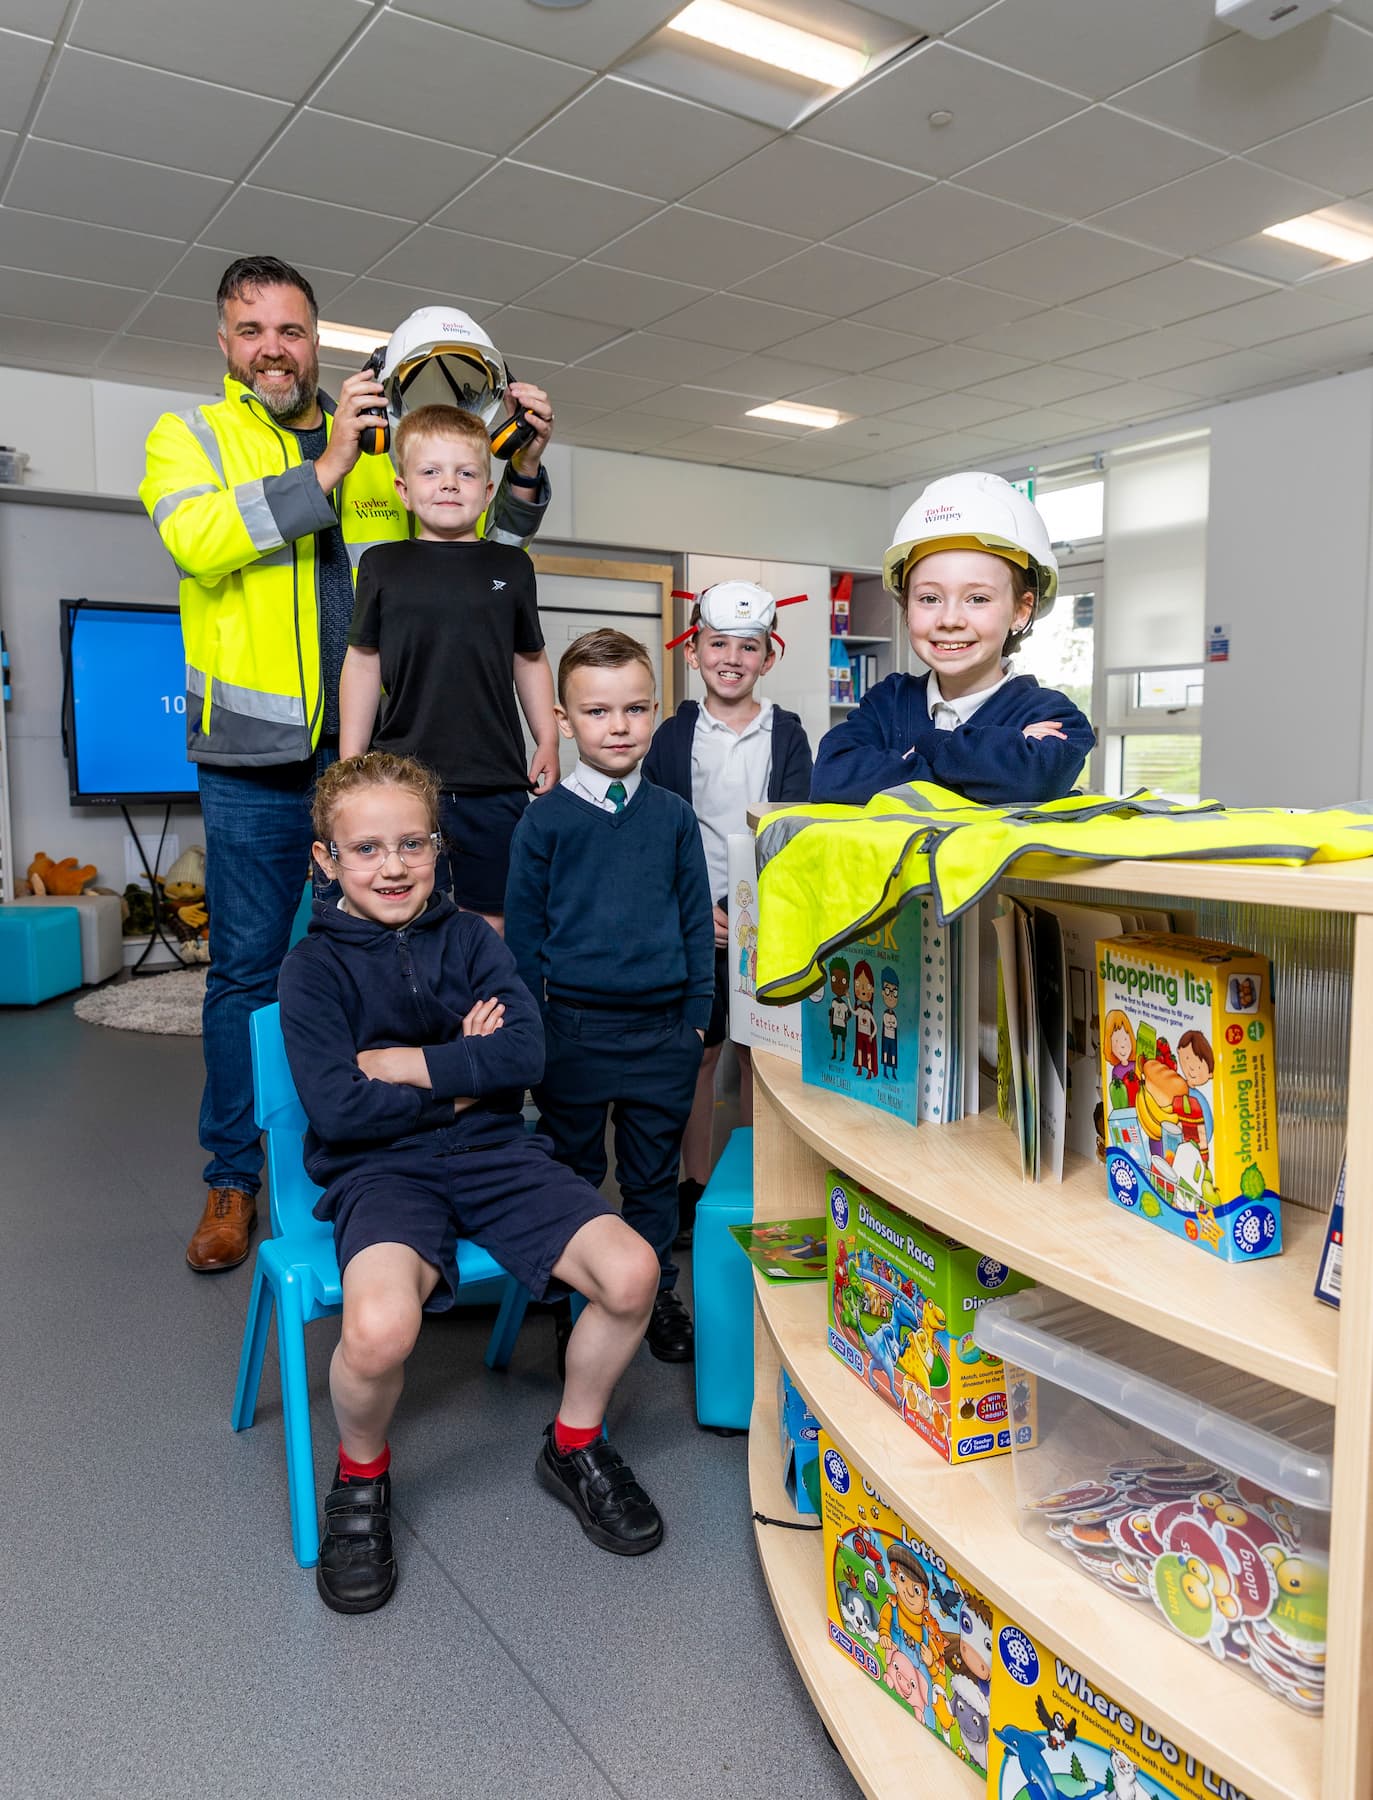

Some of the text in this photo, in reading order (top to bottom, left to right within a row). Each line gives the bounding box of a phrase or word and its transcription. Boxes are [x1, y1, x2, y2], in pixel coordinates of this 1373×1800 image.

[442, 327, 470, 336] Wimpey
[352, 498, 388, 511] Taylor
[356, 510, 399, 520] Wimpey
[926, 505, 955, 516] Taylor
[925, 512, 961, 523] Wimpey
[161, 695, 186, 714] 10
[1099, 949, 1213, 1007] shopping list
[750, 1012, 780, 1033] Patrice
[1151, 1013, 1169, 1024] memory
[1230, 1048, 1255, 1163] shopping list
[1110, 1159, 1137, 1185] ORCHARD
[833, 1188, 848, 1209] ORCHARD
[1117, 1191, 1133, 1206] TOYS
[836, 1218, 845, 1229] TOYS
[1234, 1209, 1254, 1253] ORCHARD
[1267, 1212, 1276, 1238] TOYS
[858, 1203, 935, 1272] Dinosaur Race
[986, 1279, 1002, 1287] TOYS
[863, 1300, 869, 1312] 2
[881, 1306, 887, 1317] 3
[962, 1380, 985, 1388] dinosaur
[984, 1411, 1005, 1420] medals
[826, 1451, 848, 1474] ORCHARD
[832, 1478, 845, 1492] TOYS
[901, 1523, 947, 1574] Lotto
[1239, 1548, 1259, 1600] along
[1163, 1569, 1181, 1616] when
[1001, 1629, 1037, 1662] ORCHARD
[1008, 1662, 1029, 1684] TOYS
[1054, 1657, 1136, 1735] Where
[1141, 1720, 1180, 1766] Do
[1052, 1689, 1080, 1714] Discover
[1081, 1710, 1121, 1745] fascinating
[1122, 1739, 1141, 1758] facts
[1141, 1753, 1159, 1773] with
[1160, 1766, 1174, 1782] this
